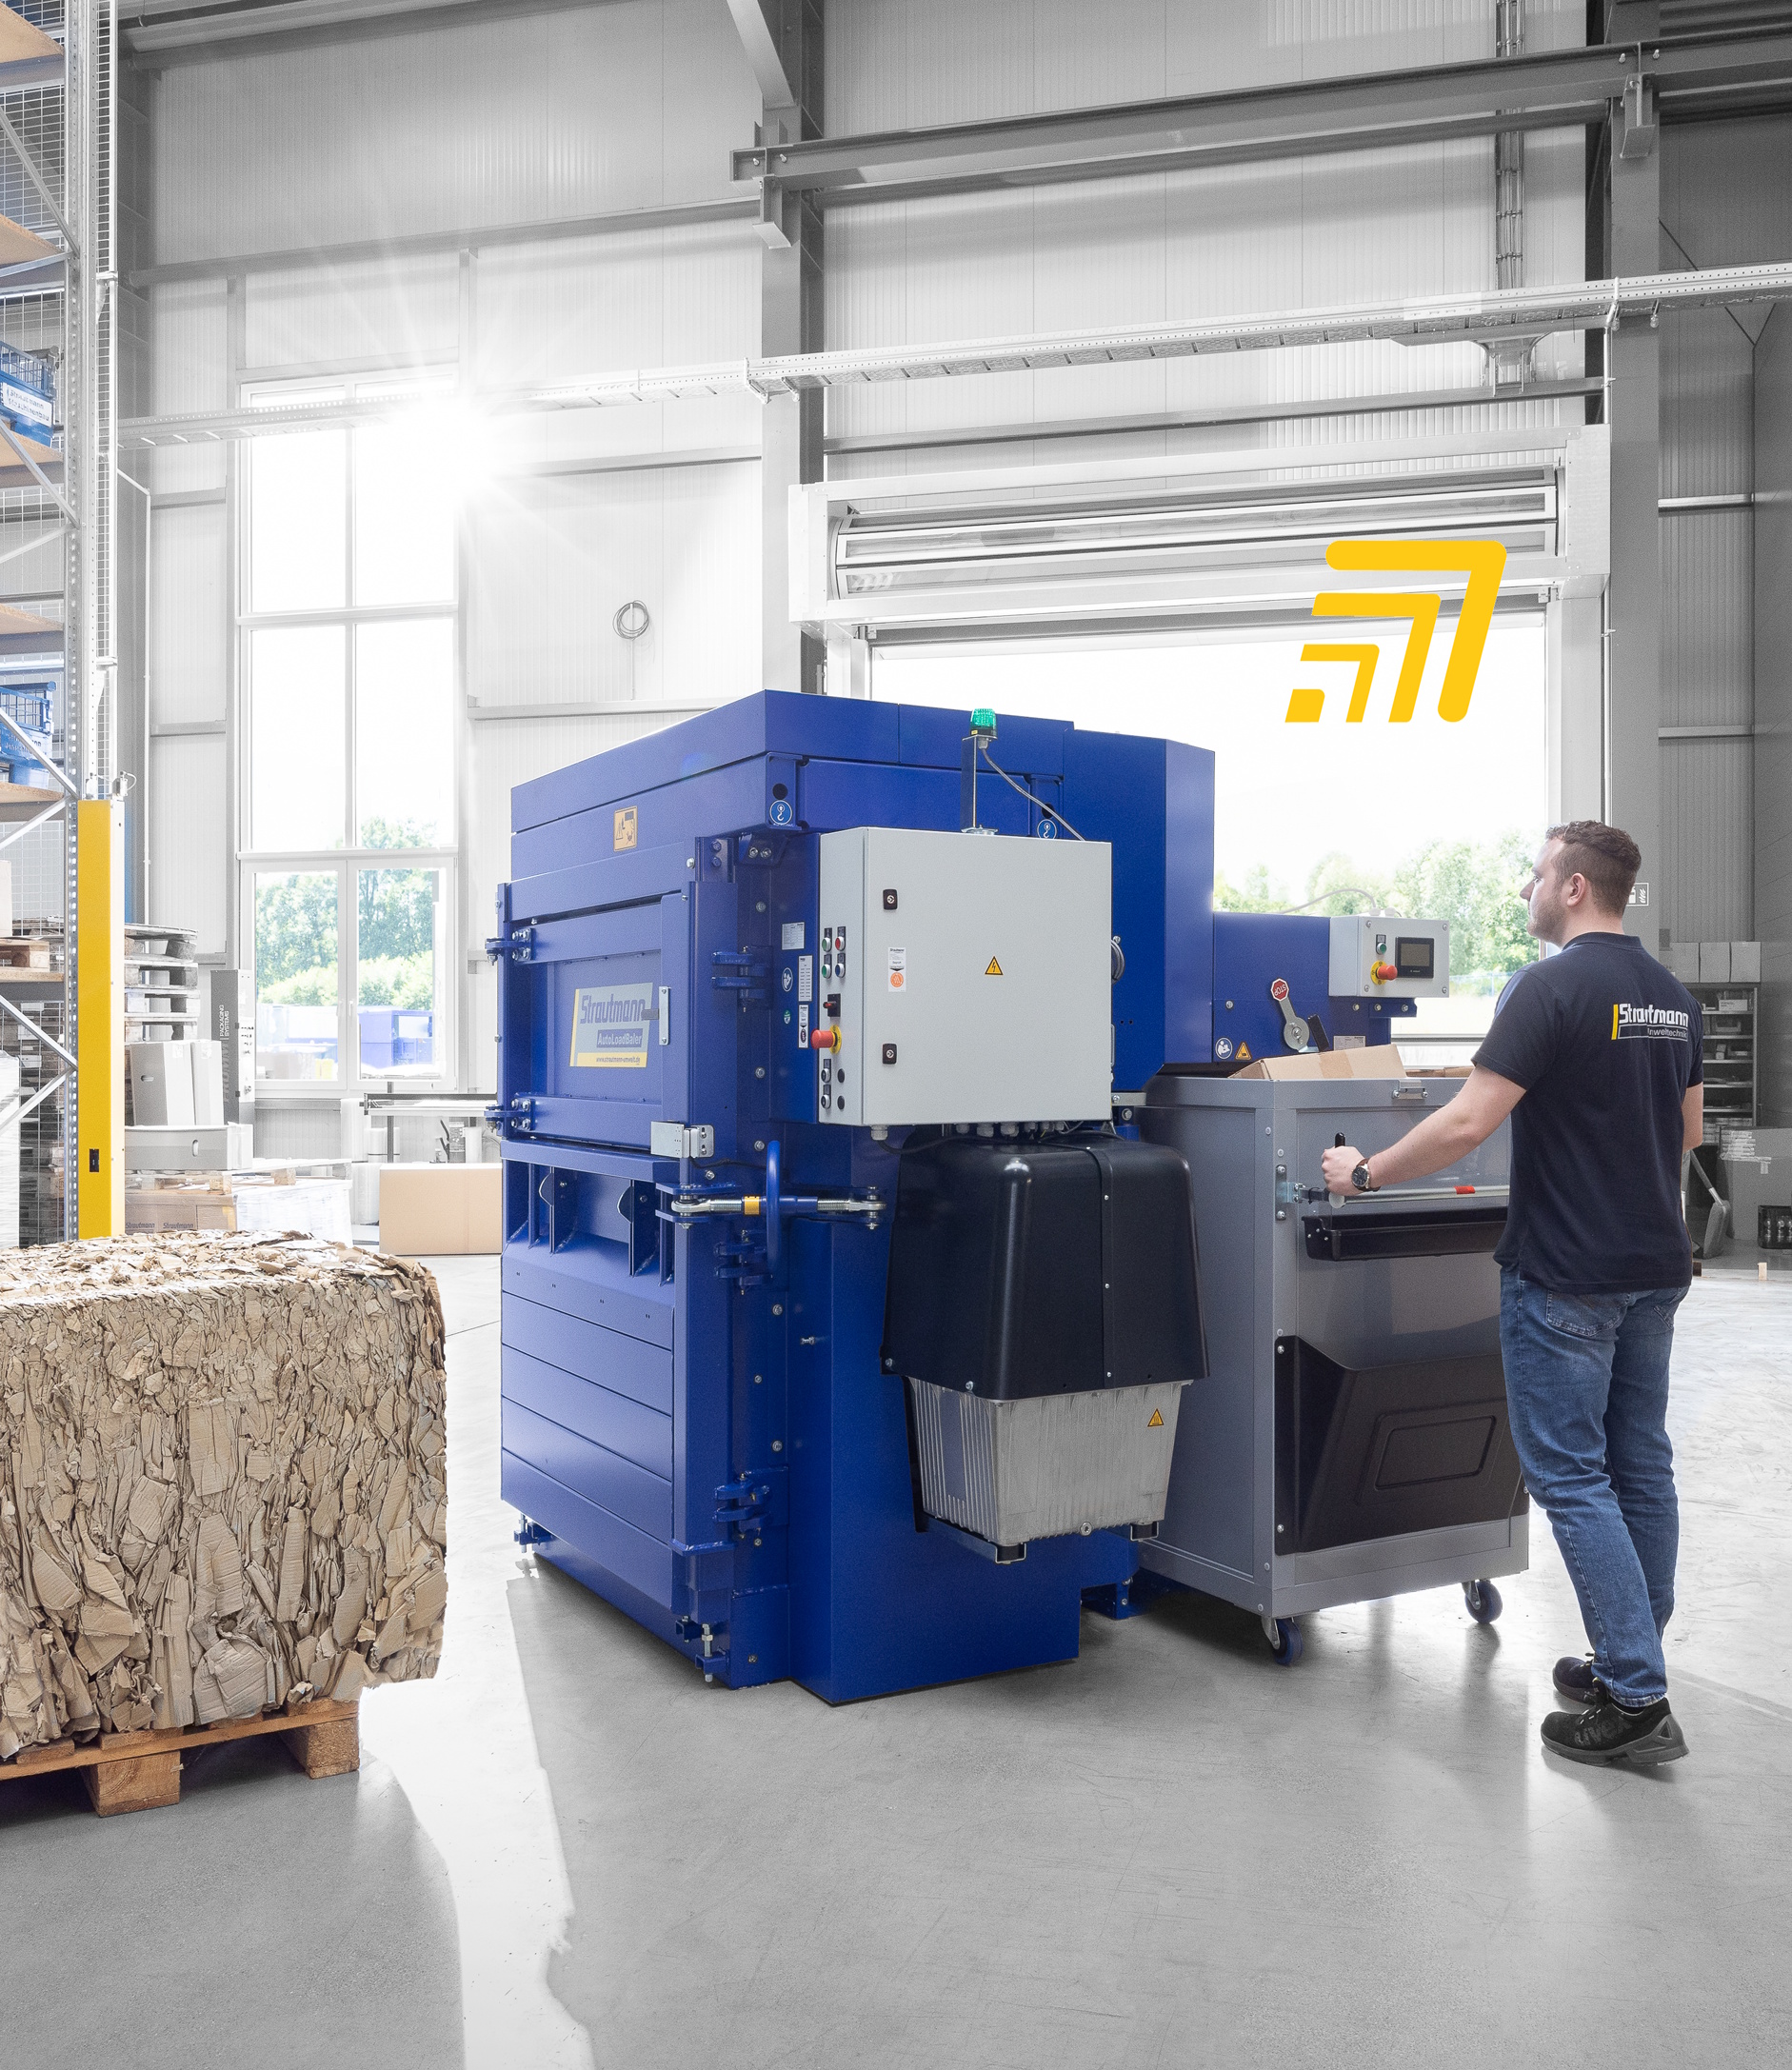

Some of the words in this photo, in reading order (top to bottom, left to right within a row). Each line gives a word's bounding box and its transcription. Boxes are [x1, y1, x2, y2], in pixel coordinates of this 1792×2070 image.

[1274, 984, 1286, 996] STOP
[580, 993, 647, 1024] Strautmann
[597, 1032, 643, 1045] AutoLoadBaler
